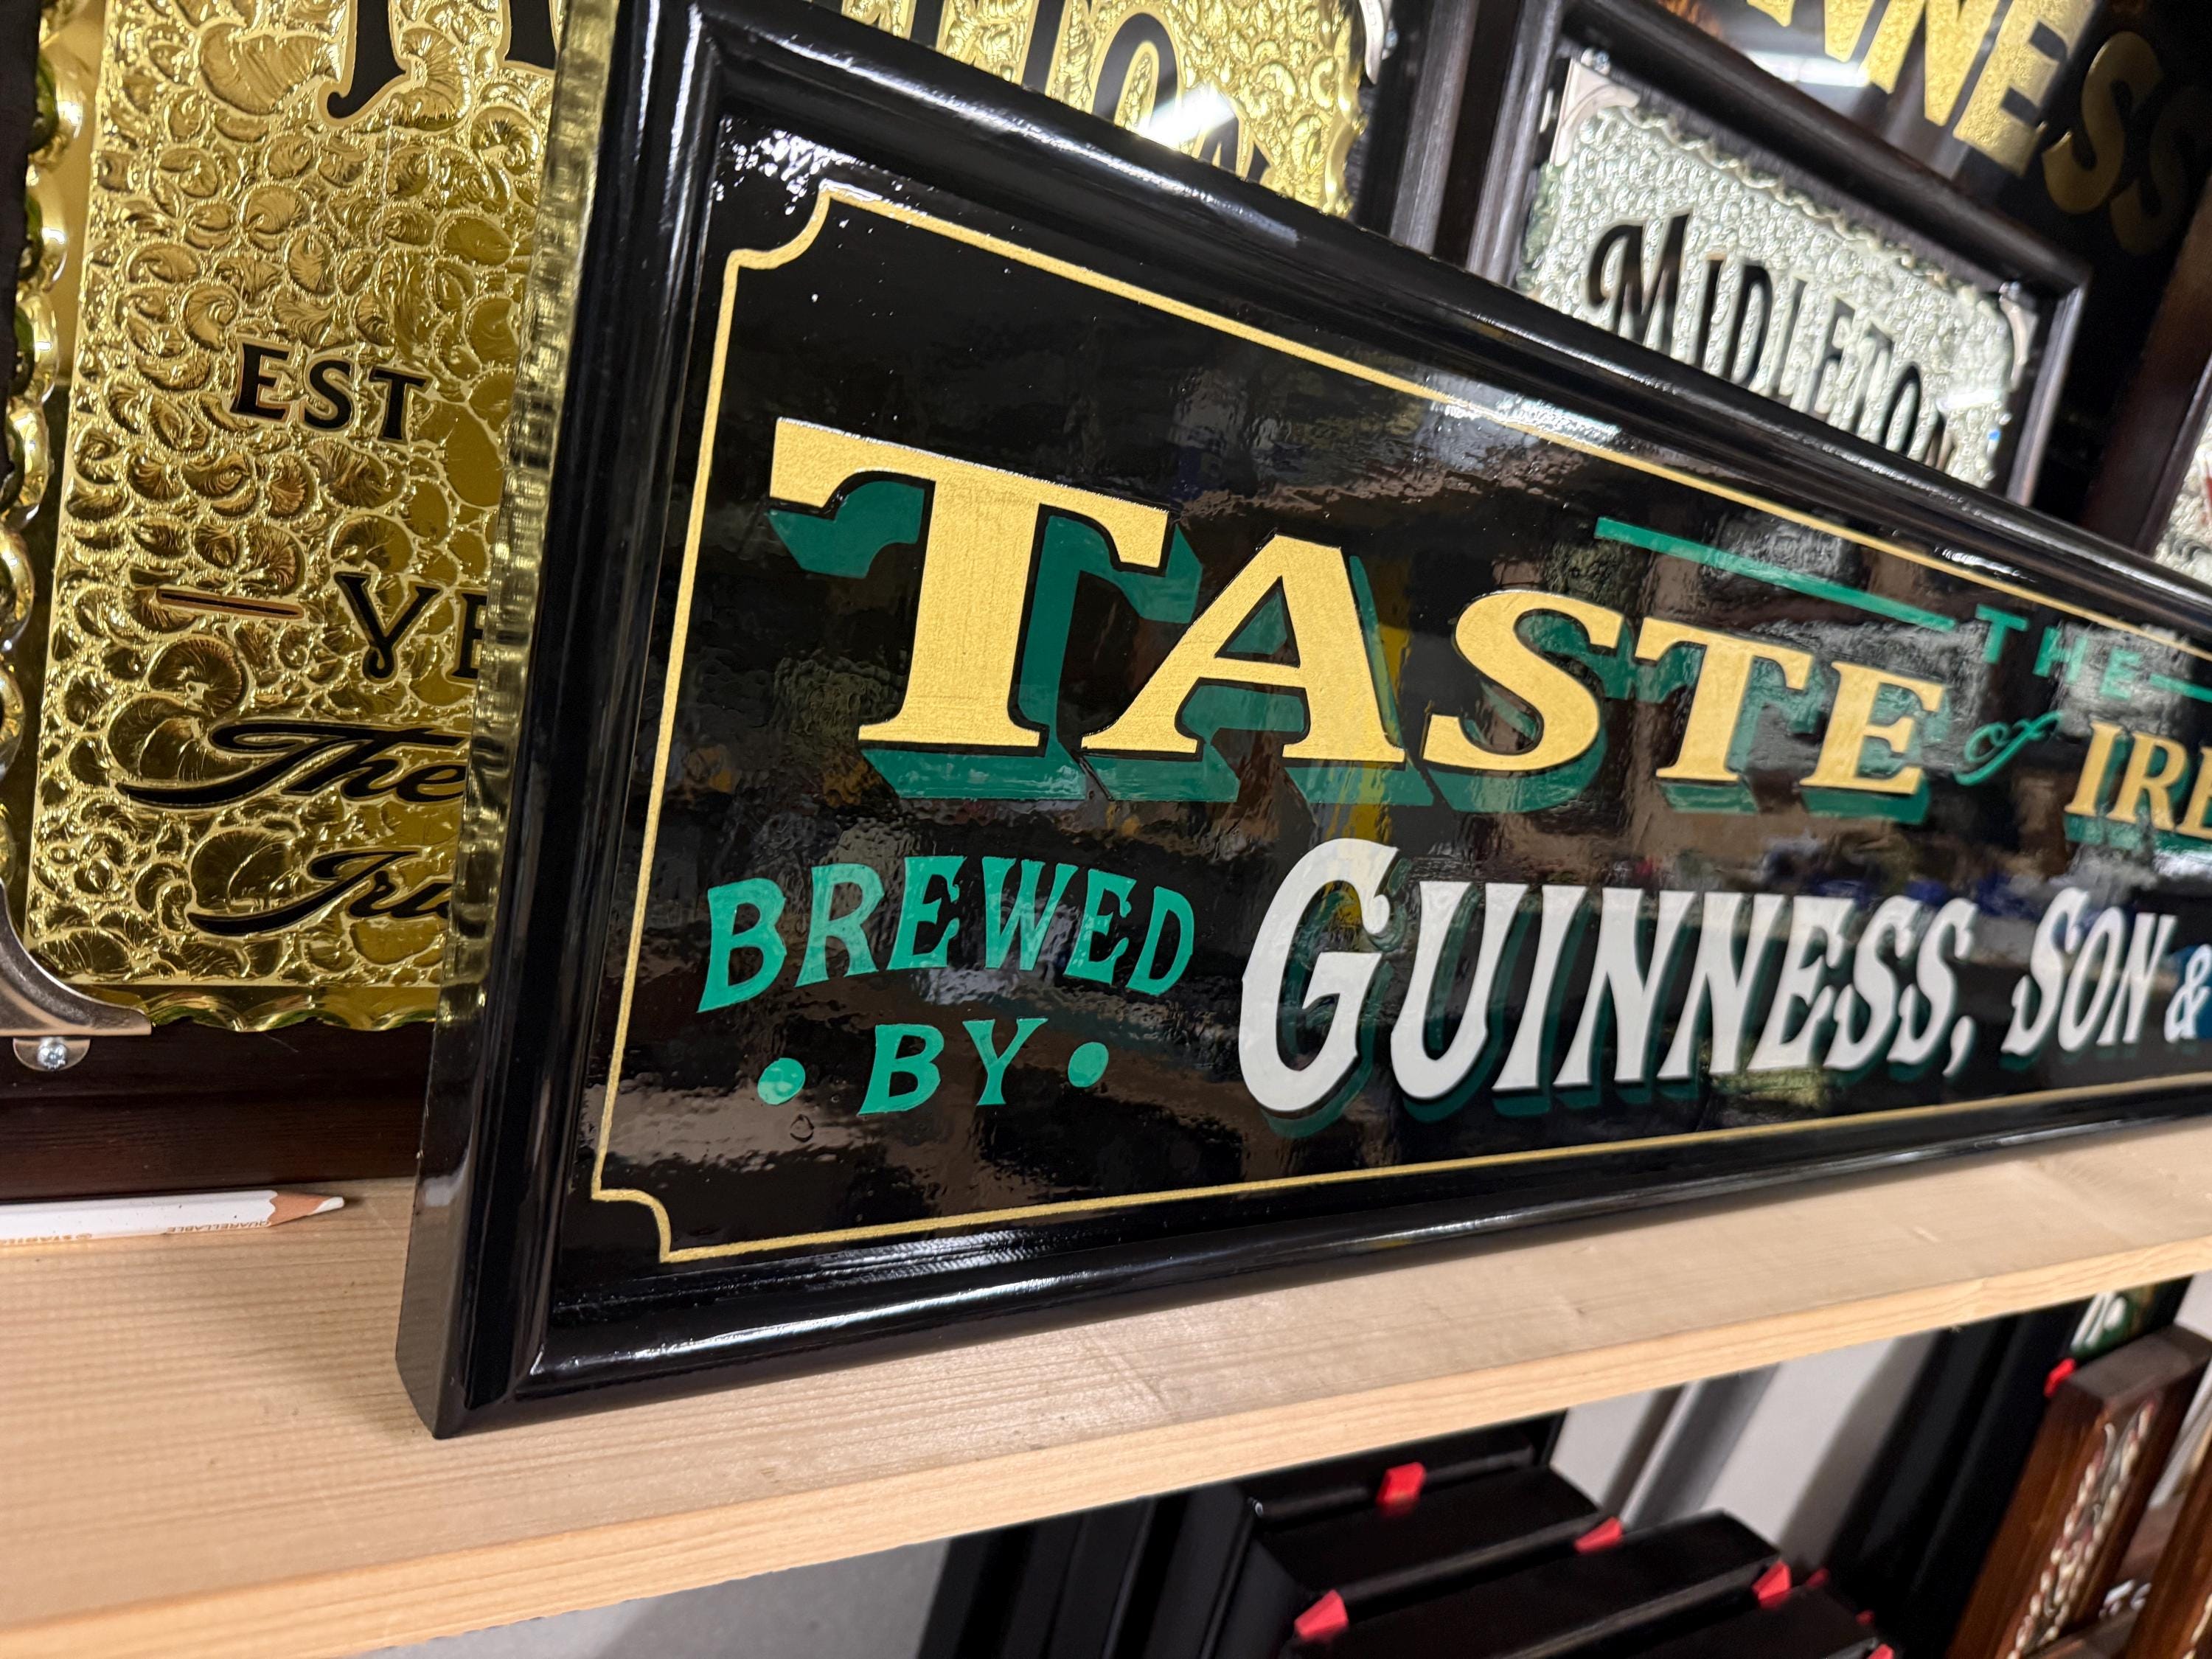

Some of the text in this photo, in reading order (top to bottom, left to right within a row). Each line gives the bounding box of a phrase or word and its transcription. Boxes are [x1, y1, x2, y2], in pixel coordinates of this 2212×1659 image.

[230, 339, 427, 441] EST
[768, 417, 1947, 800] TASTE
[1953, 711, 2063, 787] of
[1975, 603, 2143, 700] THE
[116, 721, 470, 809] The
[697, 855, 1195, 1013] BREWED
[1238, 838, 2212, 1112] GUINNESS, SON &
[857, 1018, 1048, 1116] BY
